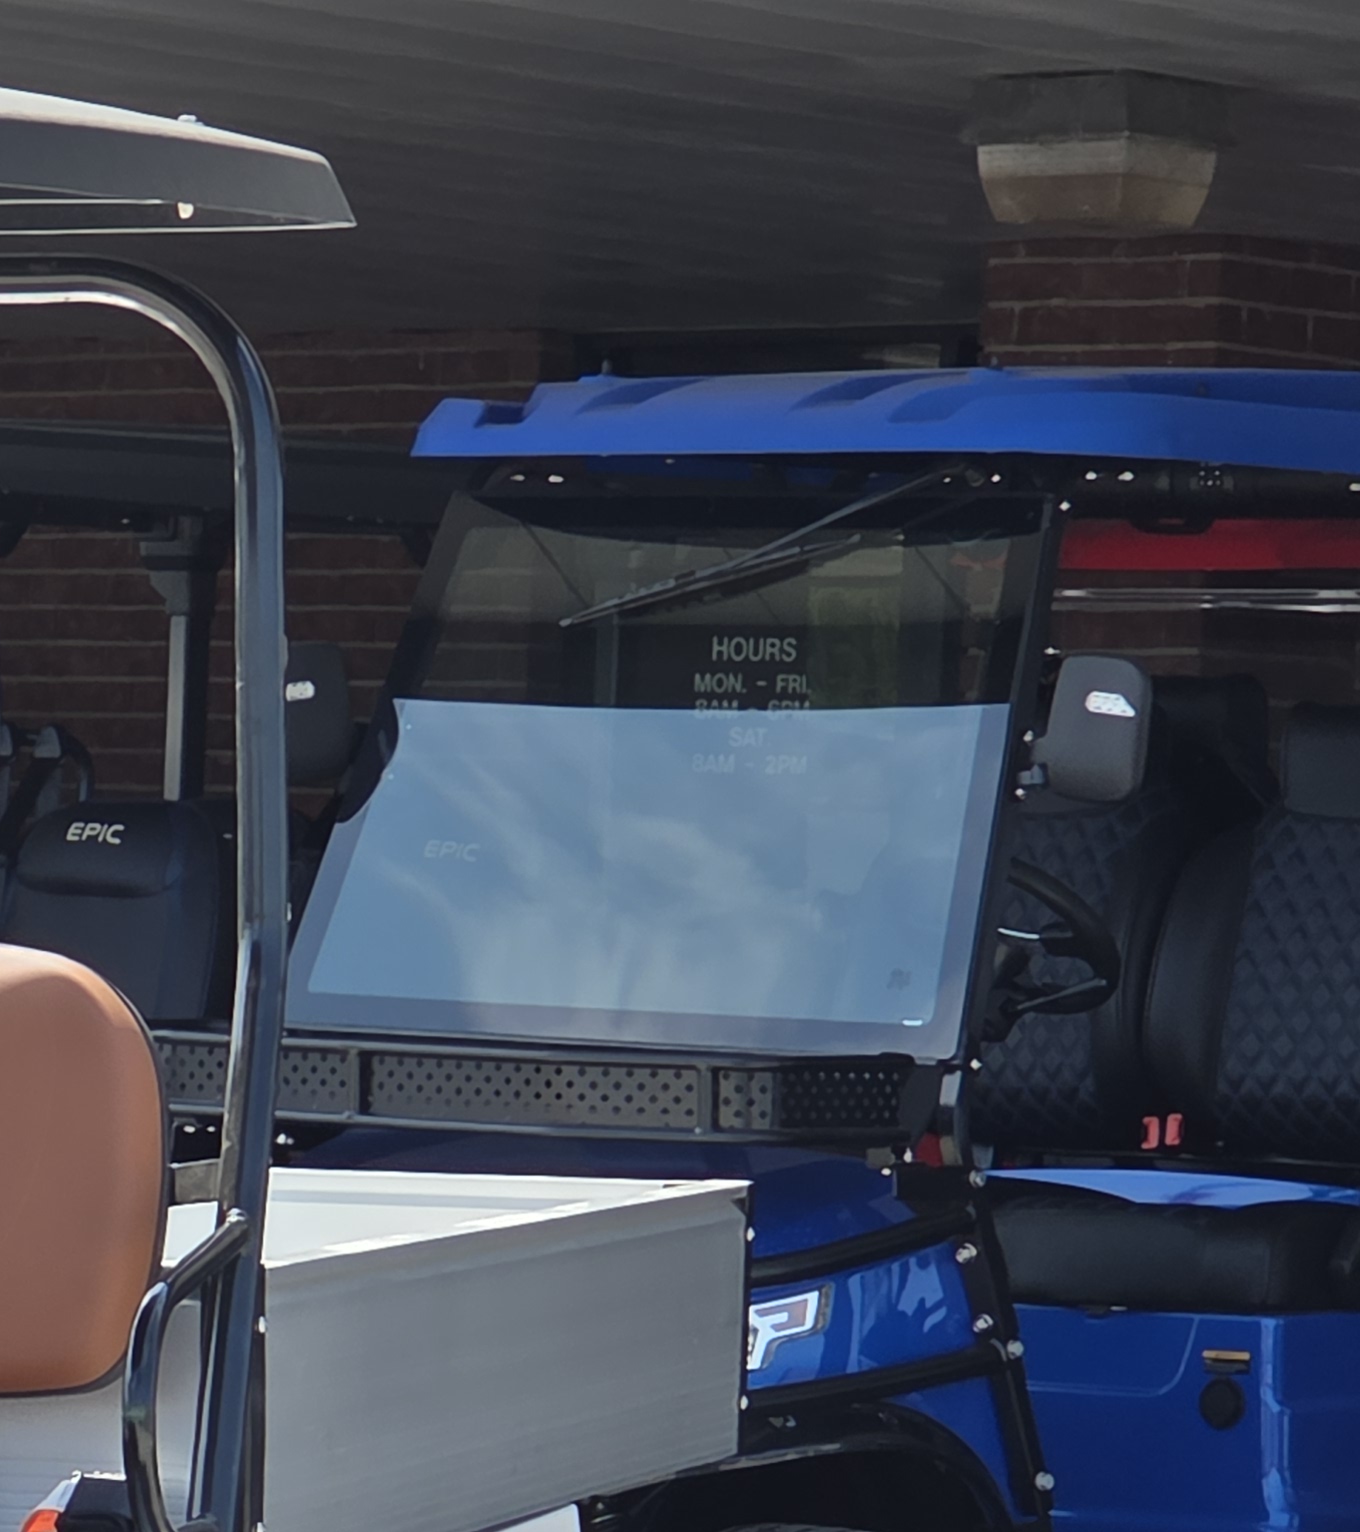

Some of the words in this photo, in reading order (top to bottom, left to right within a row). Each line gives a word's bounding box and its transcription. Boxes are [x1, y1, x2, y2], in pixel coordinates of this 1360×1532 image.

[712, 635, 797, 662] HOURS
[694, 672, 747, 693] MON.
[776, 673, 812, 694] FRI.
[66, 821, 125, 845] EPIC
[423, 839, 480, 862] EPIC
